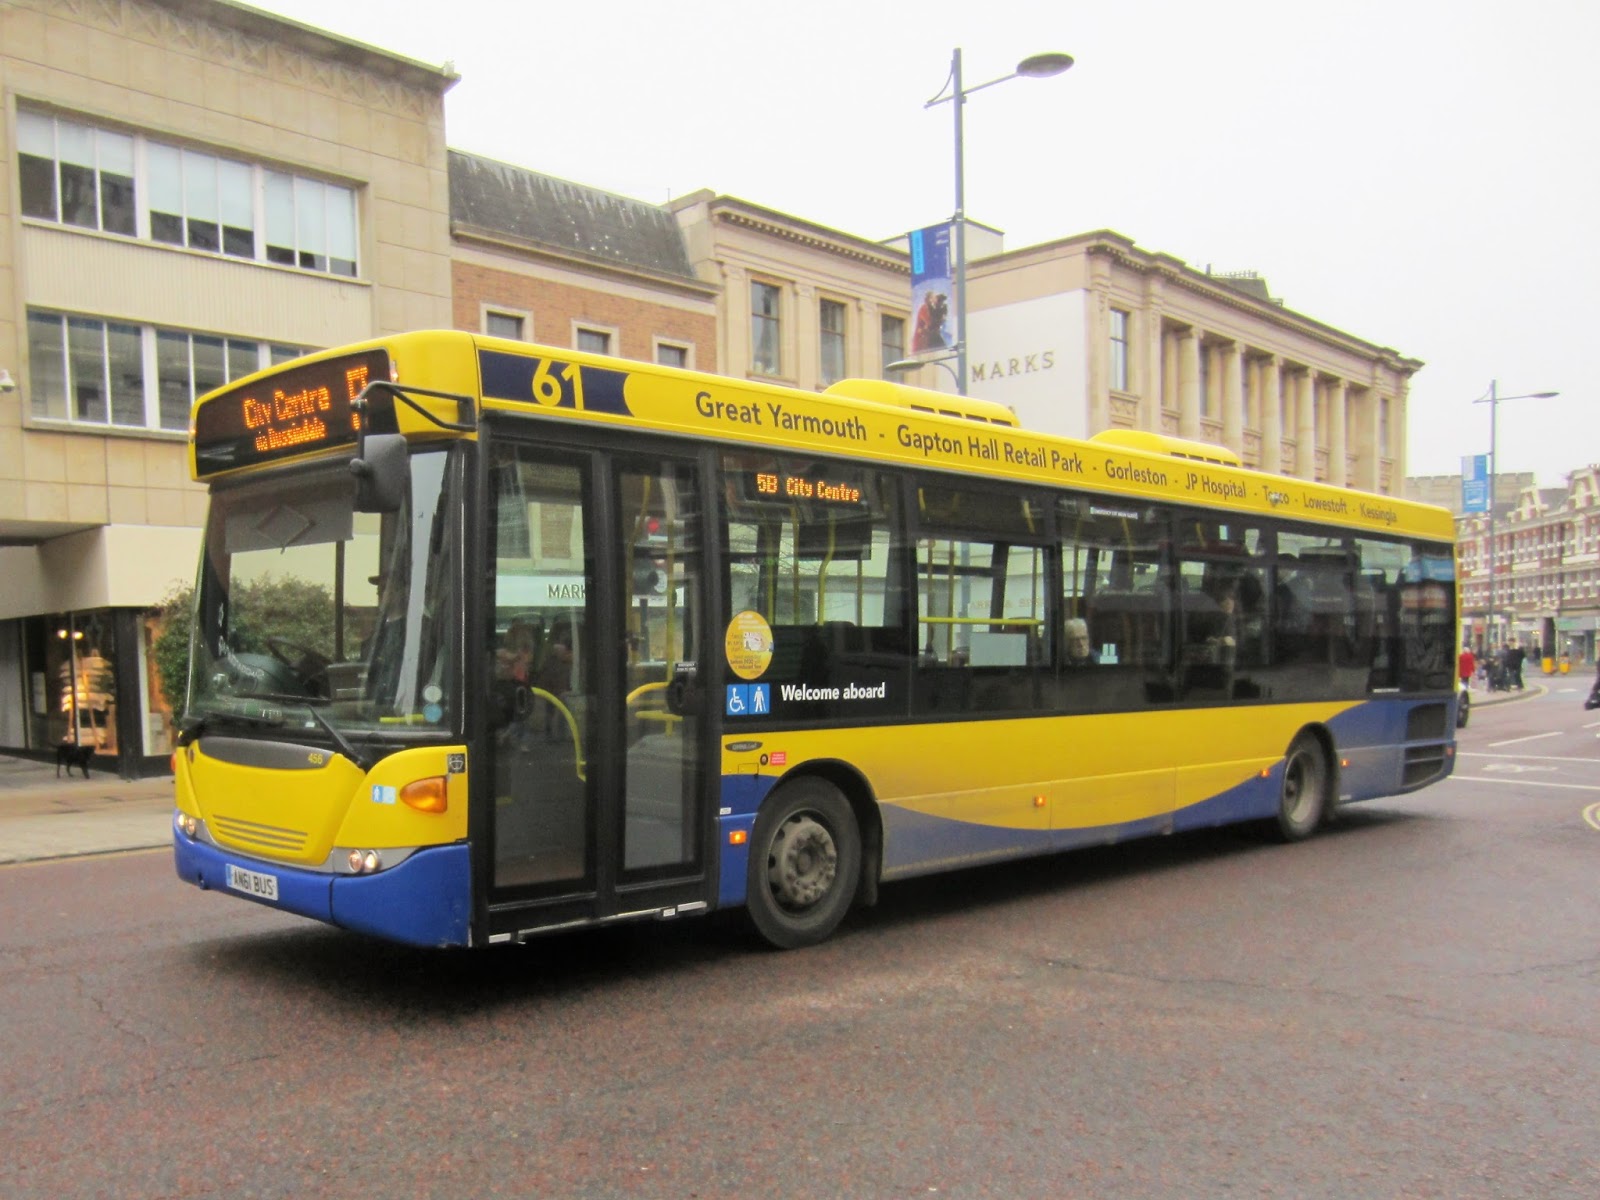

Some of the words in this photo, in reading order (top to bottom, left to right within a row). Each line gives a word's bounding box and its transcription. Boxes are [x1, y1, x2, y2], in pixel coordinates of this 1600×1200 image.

[971, 351, 1054, 383] MARKS
[532, 357, 585, 411] 61
[274, 387, 330, 420] Centre
[695, 391, 762, 426] Great
[767, 402, 867, 441] Yarmouth
[897, 424, 963, 456] Gapton
[968, 436, 999, 461] Hall
[1004, 442, 1047, 468] Retail
[1051, 450, 1083, 474] Park
[1105, 458, 1167, 486] Gorleston
[1185, 472, 1198, 491] JP
[1201, 475, 1247, 500] Hospital
[1262, 485, 1290, 505] Tco
[1303, 492, 1348, 515] Lowestoft
[757, 473, 778, 493] 5B
[786, 477, 813, 497] City
[817, 481, 859, 502] Centre
[781, 683, 840, 701] Welcome
[843, 682, 886, 700] aboard
[307, 753, 323, 765] 456
[233, 868, 252, 890] AN61
[254, 876, 274, 896] BUS
